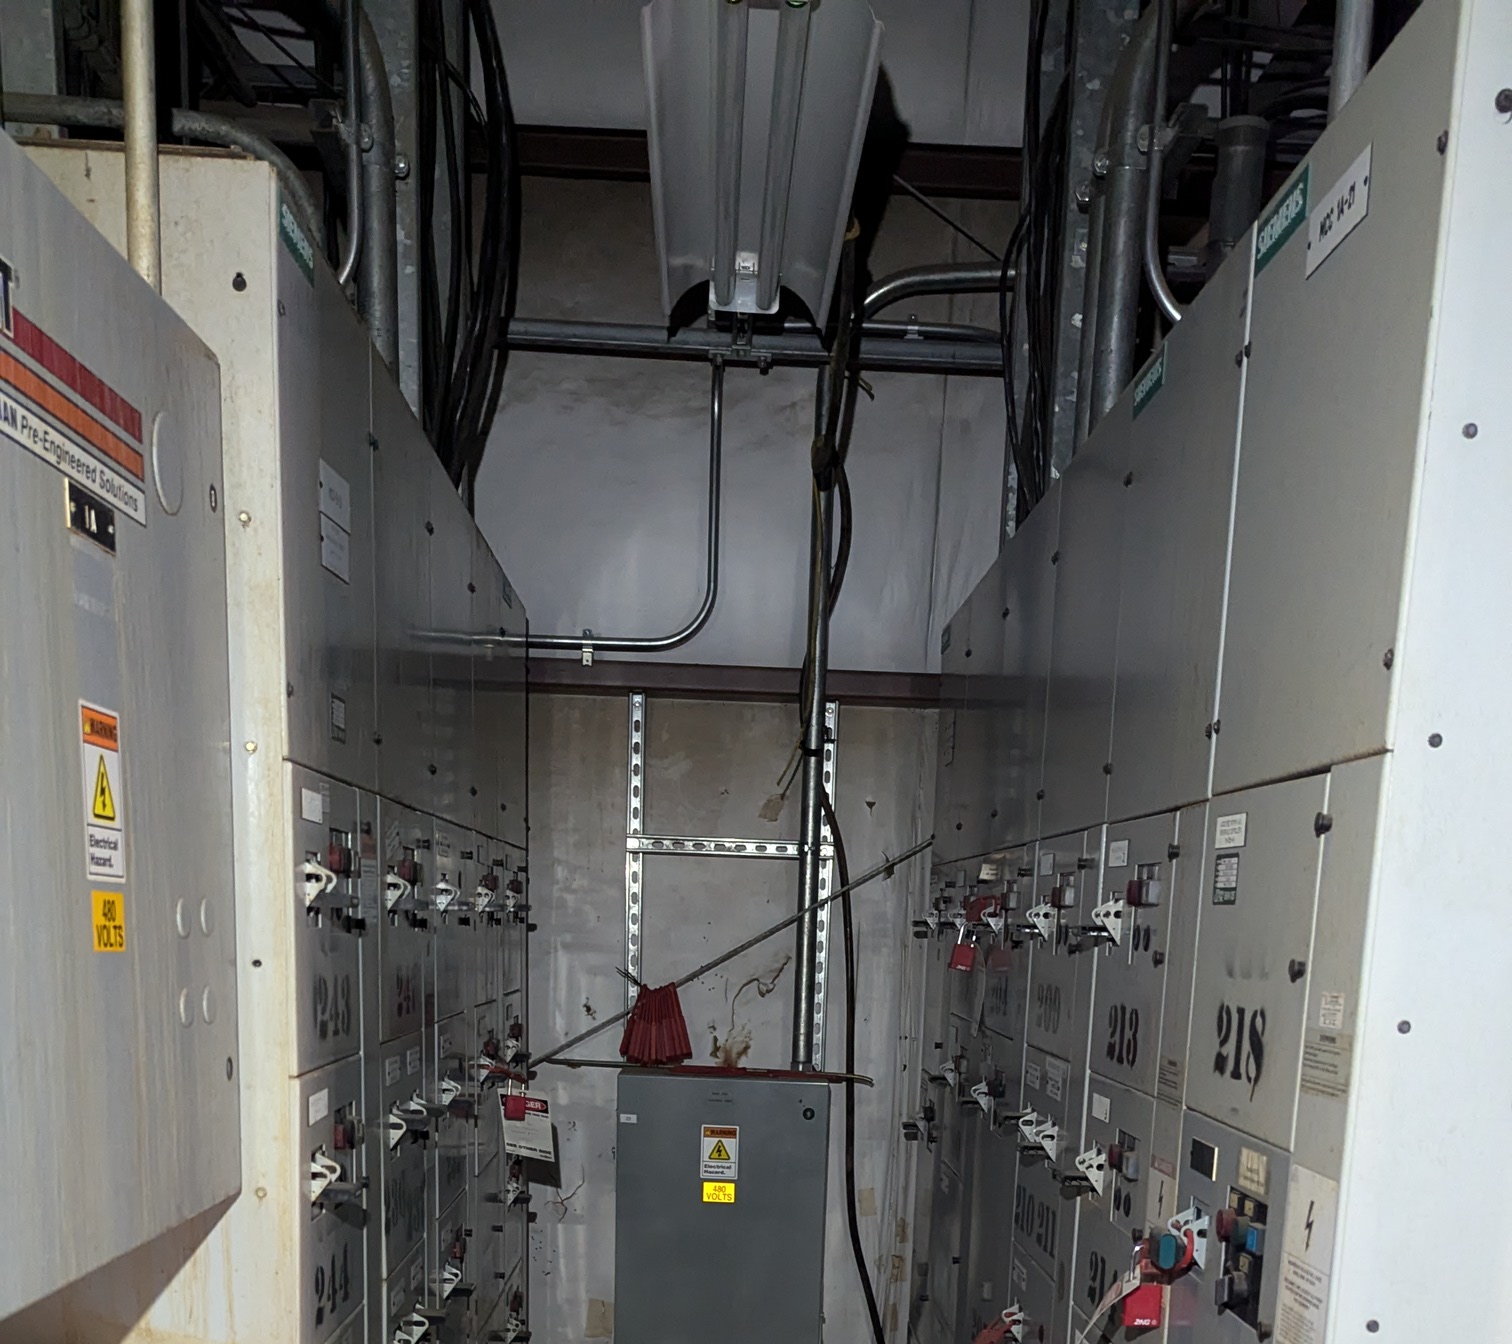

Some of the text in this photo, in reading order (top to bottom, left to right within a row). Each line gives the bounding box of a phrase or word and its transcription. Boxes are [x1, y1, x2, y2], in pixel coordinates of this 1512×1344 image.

[21, 415, 97, 484] Pre-Engineered
[100, 470, 138, 513] Solutions
[90, 834, 118, 851] Electrical
[102, 899, 116, 923] 480
[96, 924, 124, 948] VOLTS
[1213, 1002, 1266, 1096] 218
[706, 1193, 732, 1201] VOLTS
[713, 1185, 726, 1193] 480
